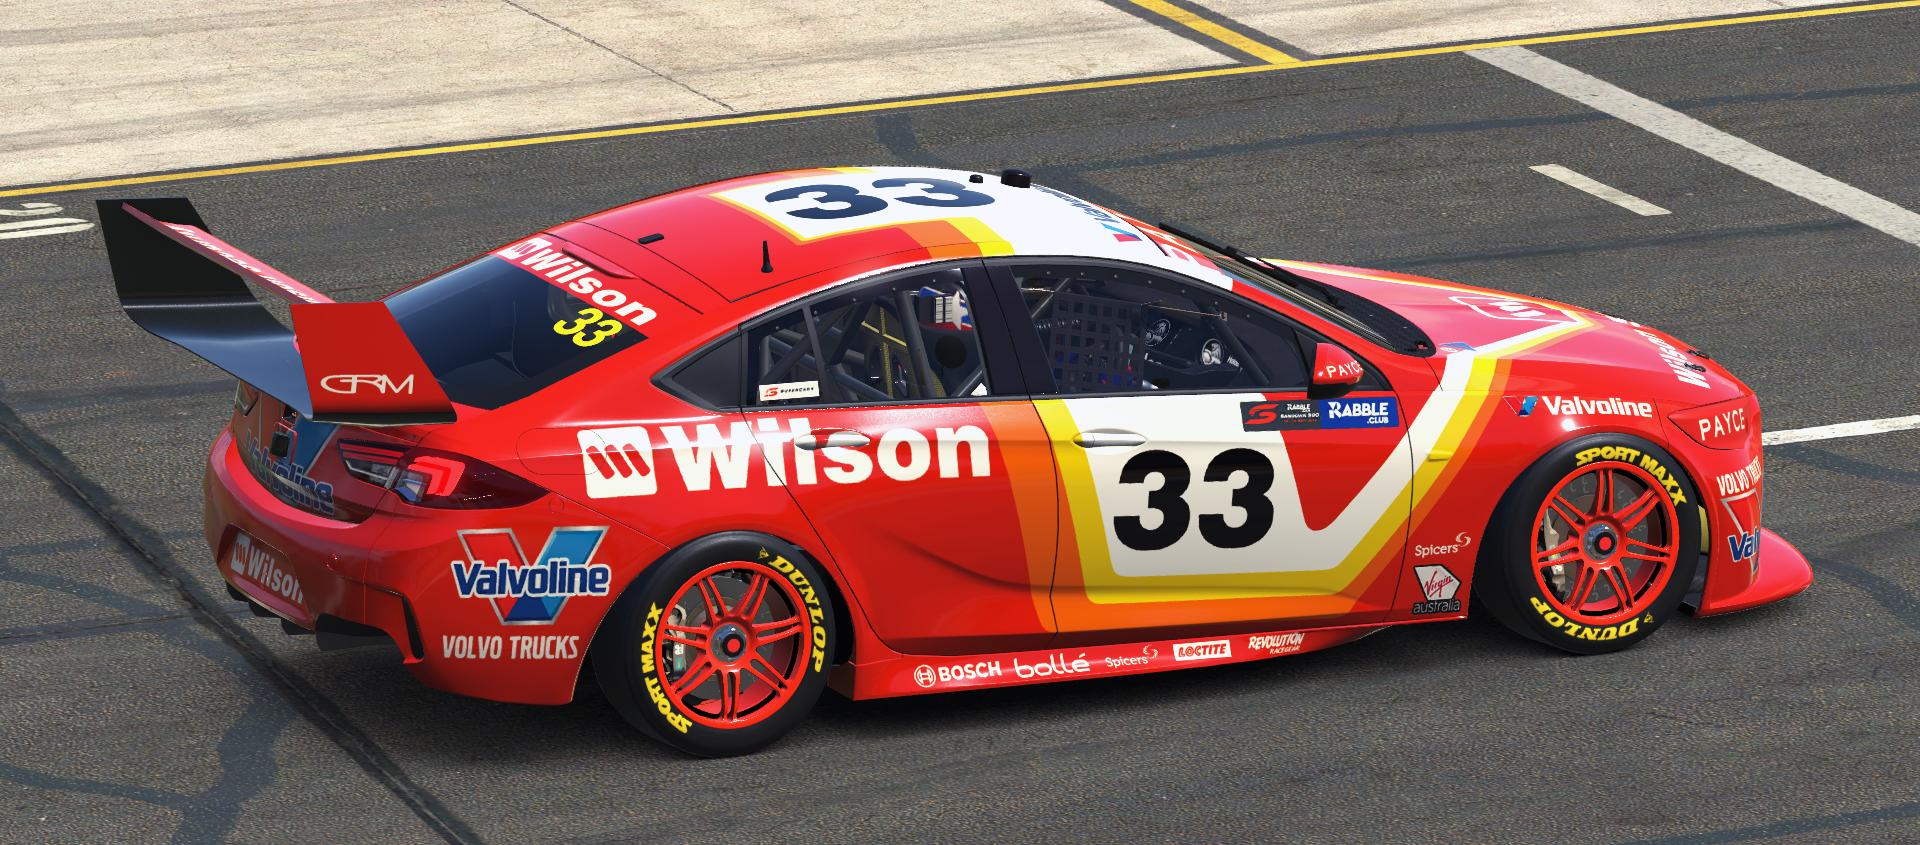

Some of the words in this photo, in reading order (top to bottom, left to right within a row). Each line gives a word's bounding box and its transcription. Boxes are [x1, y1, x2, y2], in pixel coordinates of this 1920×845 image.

[764, 177, 996, 219] 33
[520, 249, 657, 326] Wilson
[553, 307, 623, 347] 33
[1326, 360, 1363, 378] PAYC
[320, 374, 414, 395] GRM
[1328, 401, 1389, 419] RABBLE
[1367, 416, 1389, 424] .CLUB
[1542, 396, 1653, 418] Valvoline
[1699, 408, 1745, 441] PAYCE
[659, 417, 991, 492] Wilson
[1575, 446, 1640, 467] SPORT
[1640, 455, 1687, 506] MAXX
[1717, 468, 1750, 496] VOLVO
[1114, 448, 1274, 551] 33
[1414, 543, 1458, 558] Spicers
[247, 542, 304, 604] Wilson
[451, 558, 611, 598] Valvoline
[1424, 570, 1453, 598] Virgin
[768, 555, 827, 673] DUNLOP
[1413, 599, 1461, 614] australia
[1530, 596, 1639, 640] DUNLOP
[442, 635, 503, 659] VOLVO
[509, 635, 580, 660] TRUCKS
[641, 601, 663, 673] MAXX
[1178, 643, 1227, 658] LOCTITE
[1248, 632, 1305, 650] REVOLUTION
[938, 660, 1001, 682] BOSCH
[1014, 652, 1091, 679] bollé
[1105, 655, 1148, 668] Spicers
[644, 676, 693, 734] SPORT
